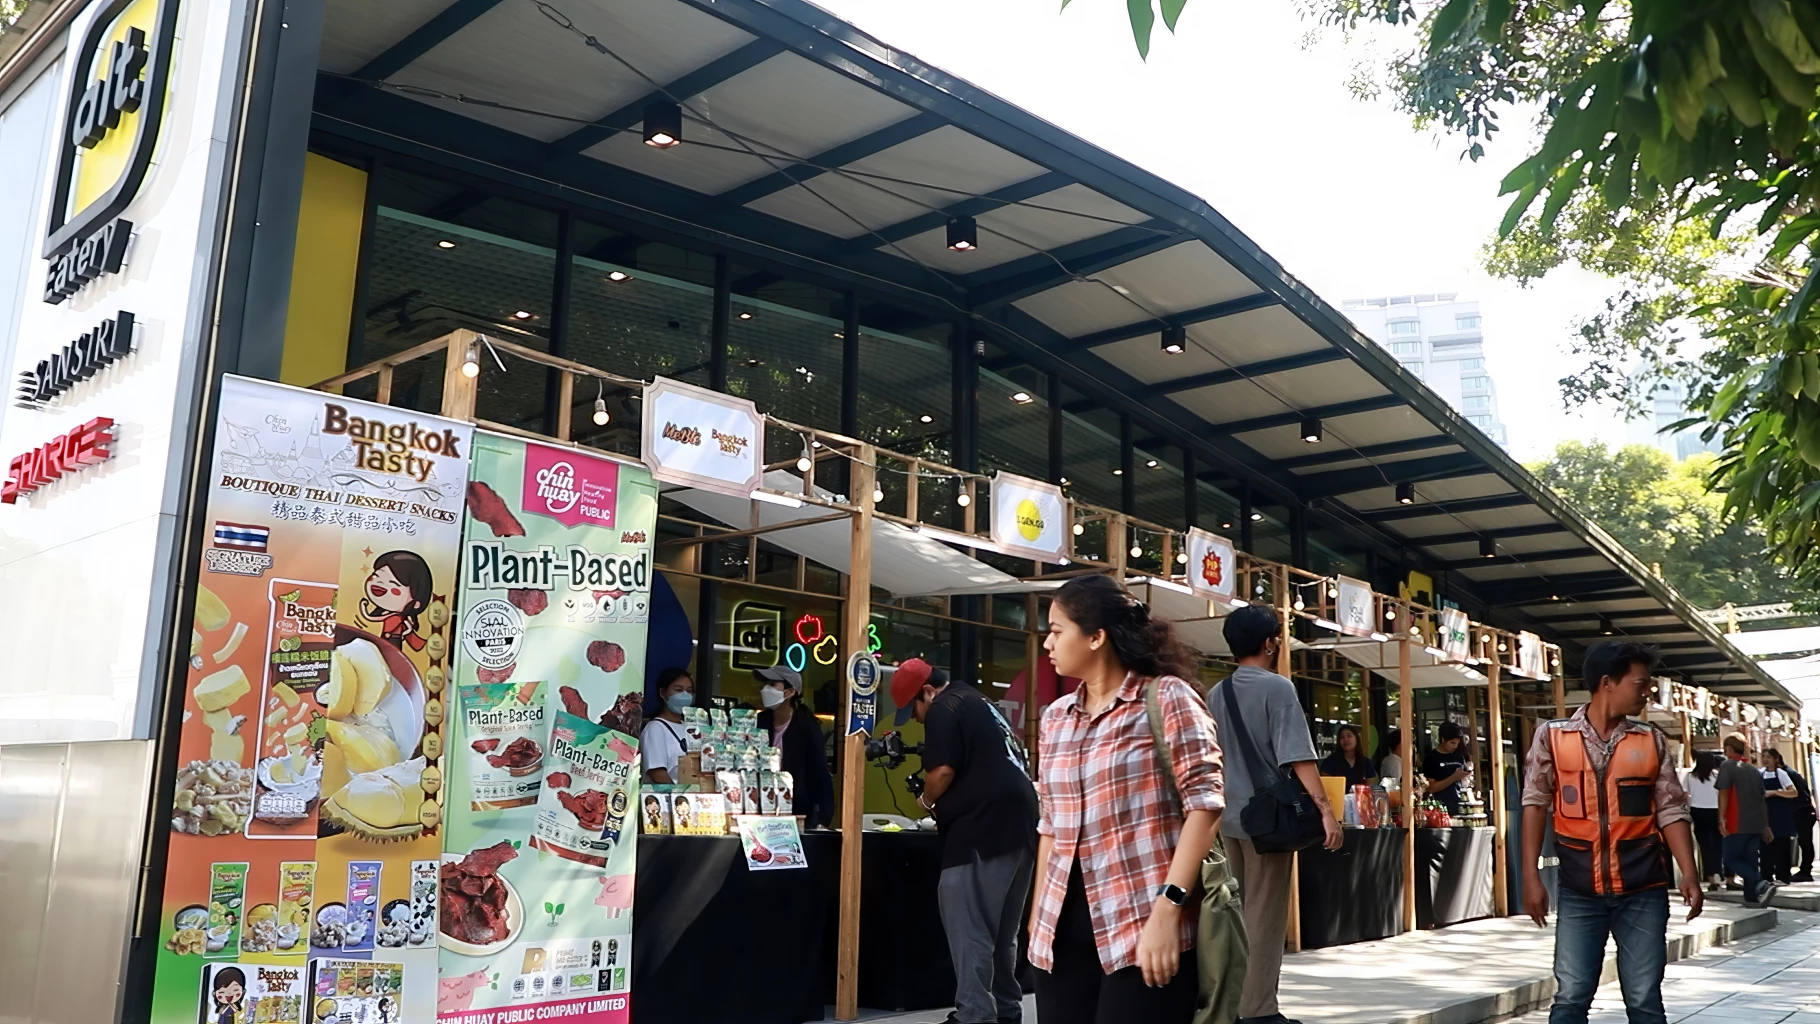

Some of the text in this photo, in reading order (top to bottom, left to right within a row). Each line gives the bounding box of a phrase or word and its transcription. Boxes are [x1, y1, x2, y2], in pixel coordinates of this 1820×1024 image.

[72, 26, 149, 149] alt.
[43, 218, 133, 305] Eatery
[15, 310, 135, 405] SANSIRI
[322, 402, 461, 459] Bangkok
[711, 428, 748, 447] Bangkok
[1, 416, 115, 505] SHARGE
[352, 439, 436, 482] Tasty
[536, 462, 574, 489] chin
[220, 475, 457, 523] BOUTIQUE THAI DESSERT SNACKS
[537, 482, 581, 513] huay
[580, 505, 610, 520] PUBLIC
[471, 545, 647, 588] Plant-Based
[286, 603, 336, 624] Bangk
[475, 602, 510, 616] SELECTION
[299, 618, 336, 636] Tasty
[461, 626, 524, 640] INNOVATION
[480, 616, 508, 629] SIAL
[485, 638, 506, 646] PARIS
[743, 625, 778, 651] alt.
[482, 652, 515, 665] SELECTION
[469, 706, 544, 725] Plant-Based
[853, 703, 874, 716] TASTE
[555, 738, 630, 777] Plant-Based
[257, 967, 300, 983] Bangkok
[266, 979, 292, 993] Tasty
[464, 1012, 496, 1024] HUAY
[497, 1009, 535, 1024] PUBLIC
[536, 1002, 587, 1019] COMPANY
[588, 997, 626, 1014] LIMITED
